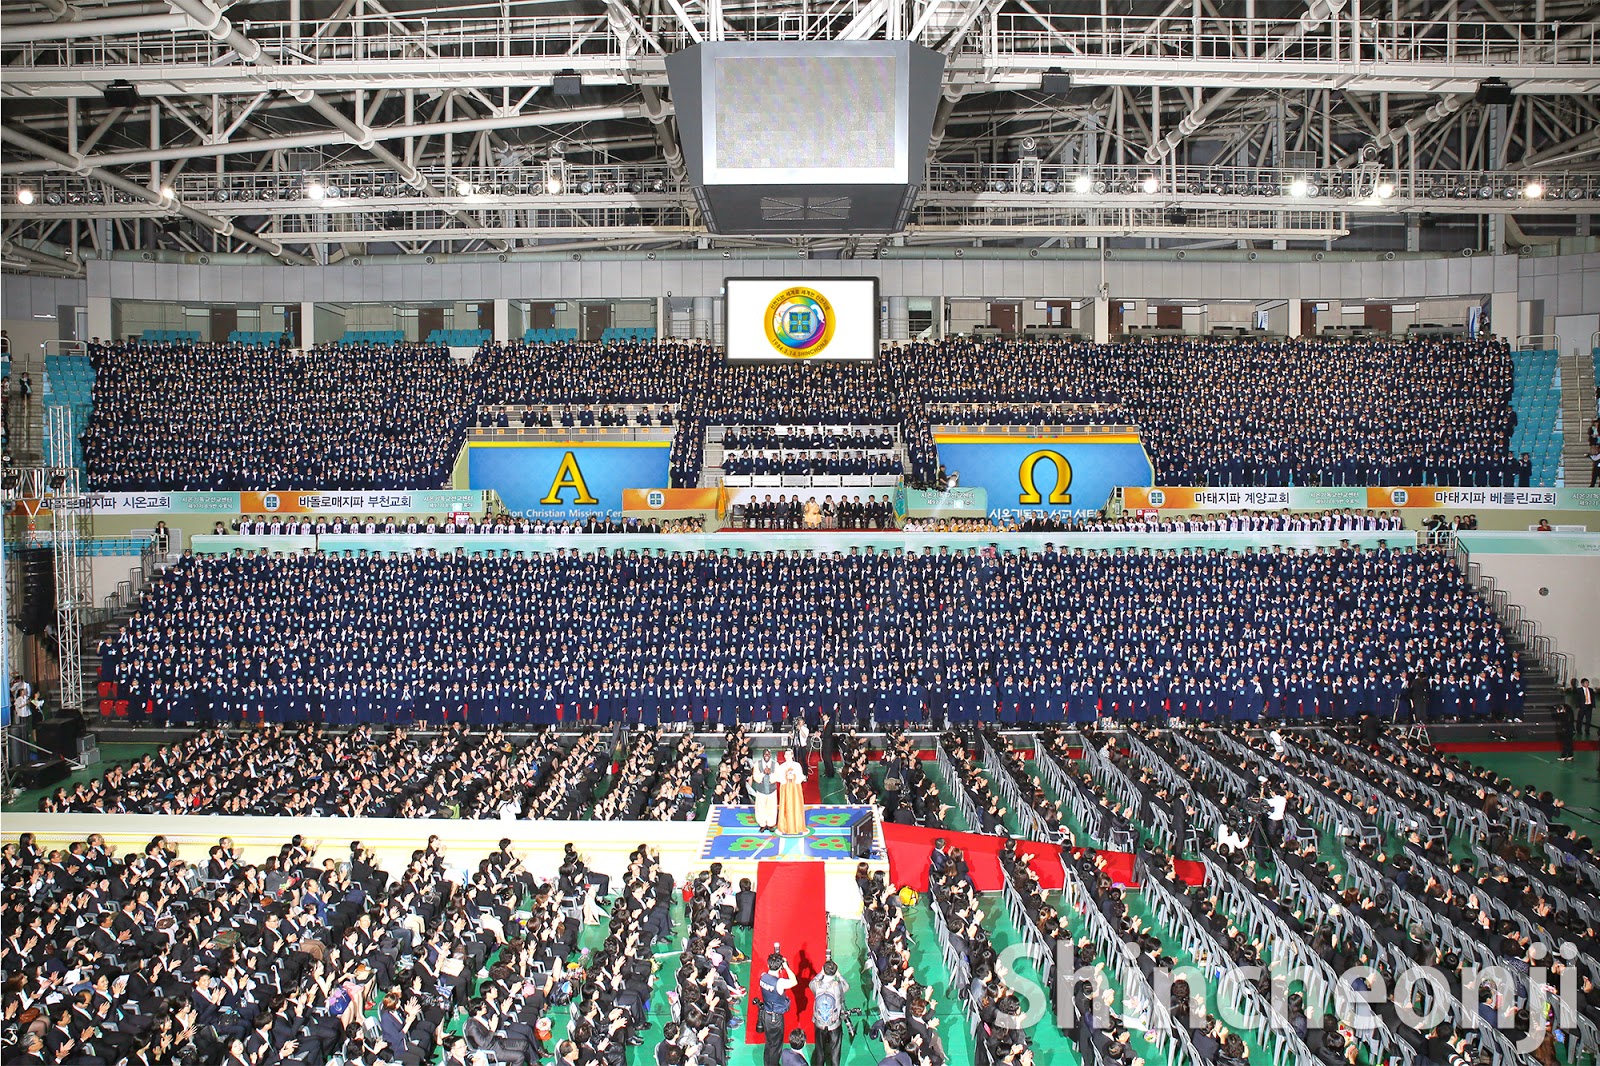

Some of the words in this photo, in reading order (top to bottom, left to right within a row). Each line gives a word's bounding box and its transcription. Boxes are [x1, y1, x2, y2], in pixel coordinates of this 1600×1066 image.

[540, 451, 599, 505] A
[1019, 449, 1072, 505] Ω
[123, 497, 171, 509] 시온교회
[299, 495, 364, 508] 바돌로매지파
[367, 495, 412, 508] 부천교회
[1195, 491, 1241, 504] 마태지파
[1244, 491, 1290, 504] 계양교회
[1435, 491, 1486, 504] 마태지파
[1490, 491, 1557, 505] 베를린교회
[509, 509, 523, 518] ion
[526, 508, 566, 518] Christian
[569, 508, 604, 518] Mission
